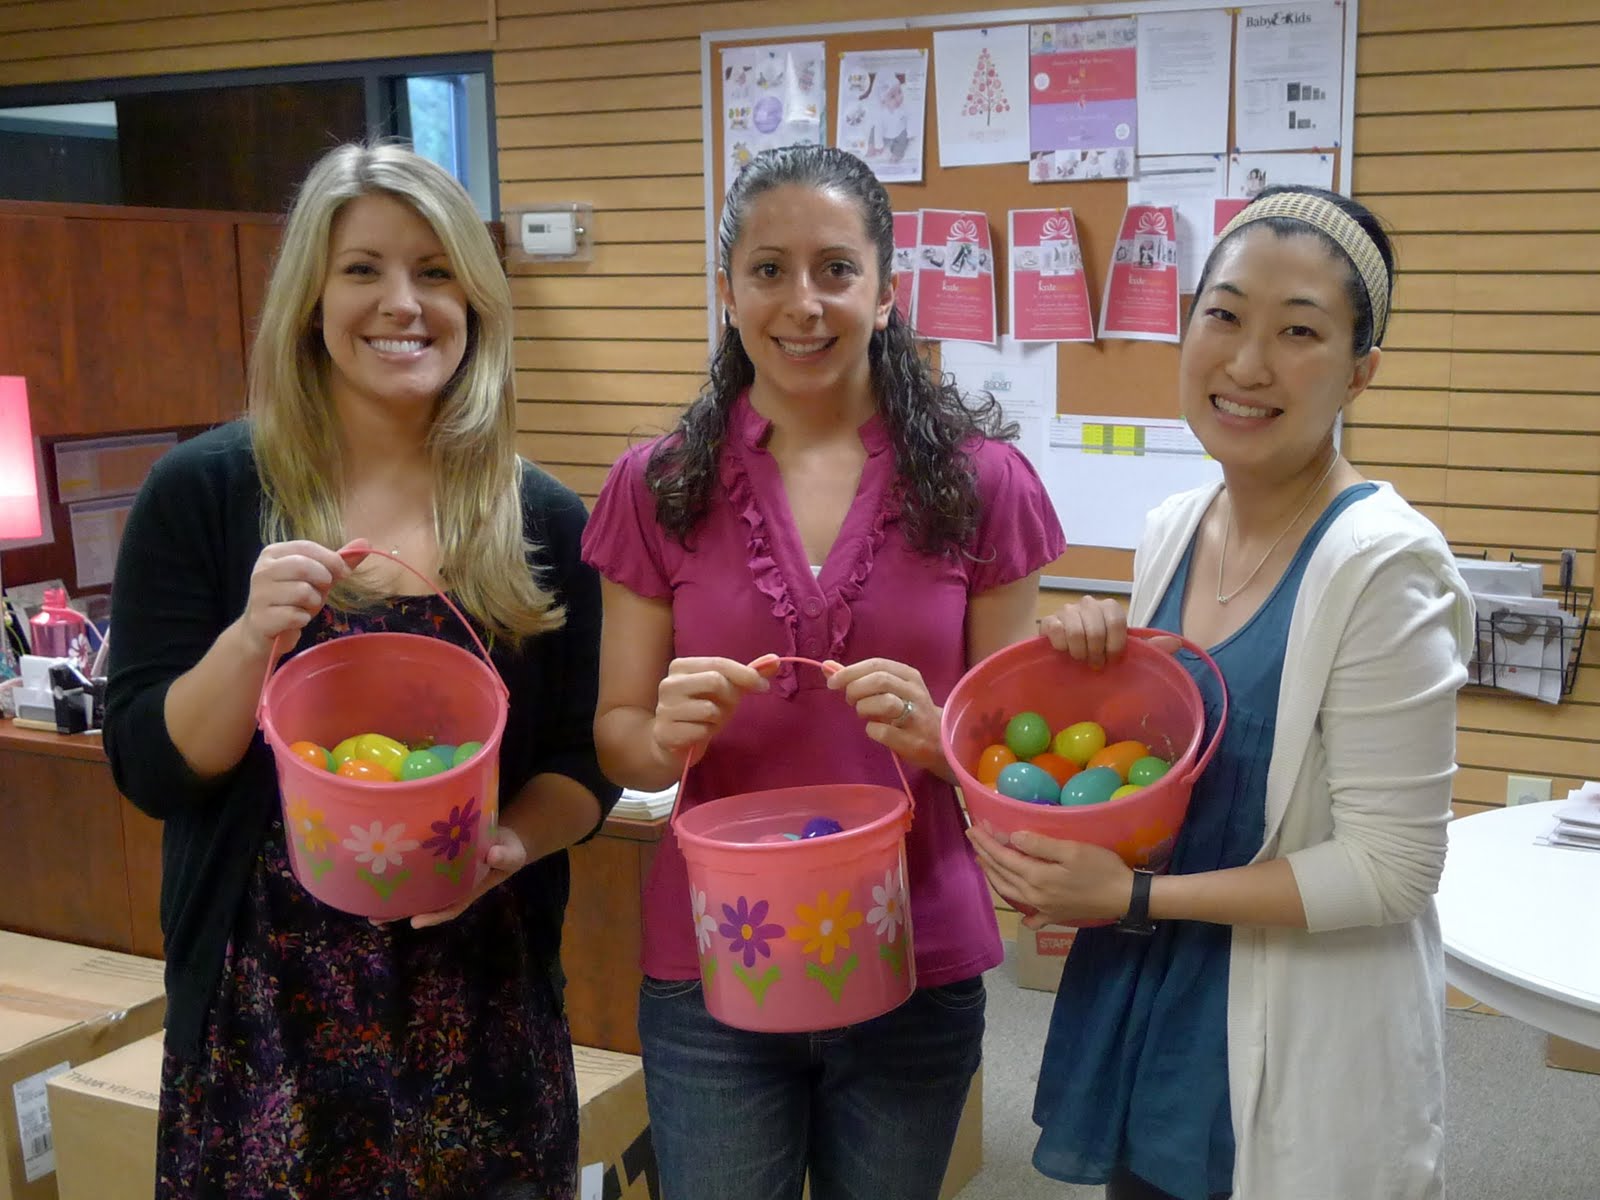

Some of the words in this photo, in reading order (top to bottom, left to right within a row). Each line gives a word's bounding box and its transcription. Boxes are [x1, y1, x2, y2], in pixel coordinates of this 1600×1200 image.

[1246, 14, 1274, 29] Baby
[1284, 11, 1312, 25] Kids
[66, 1071, 106, 1089] THANK
